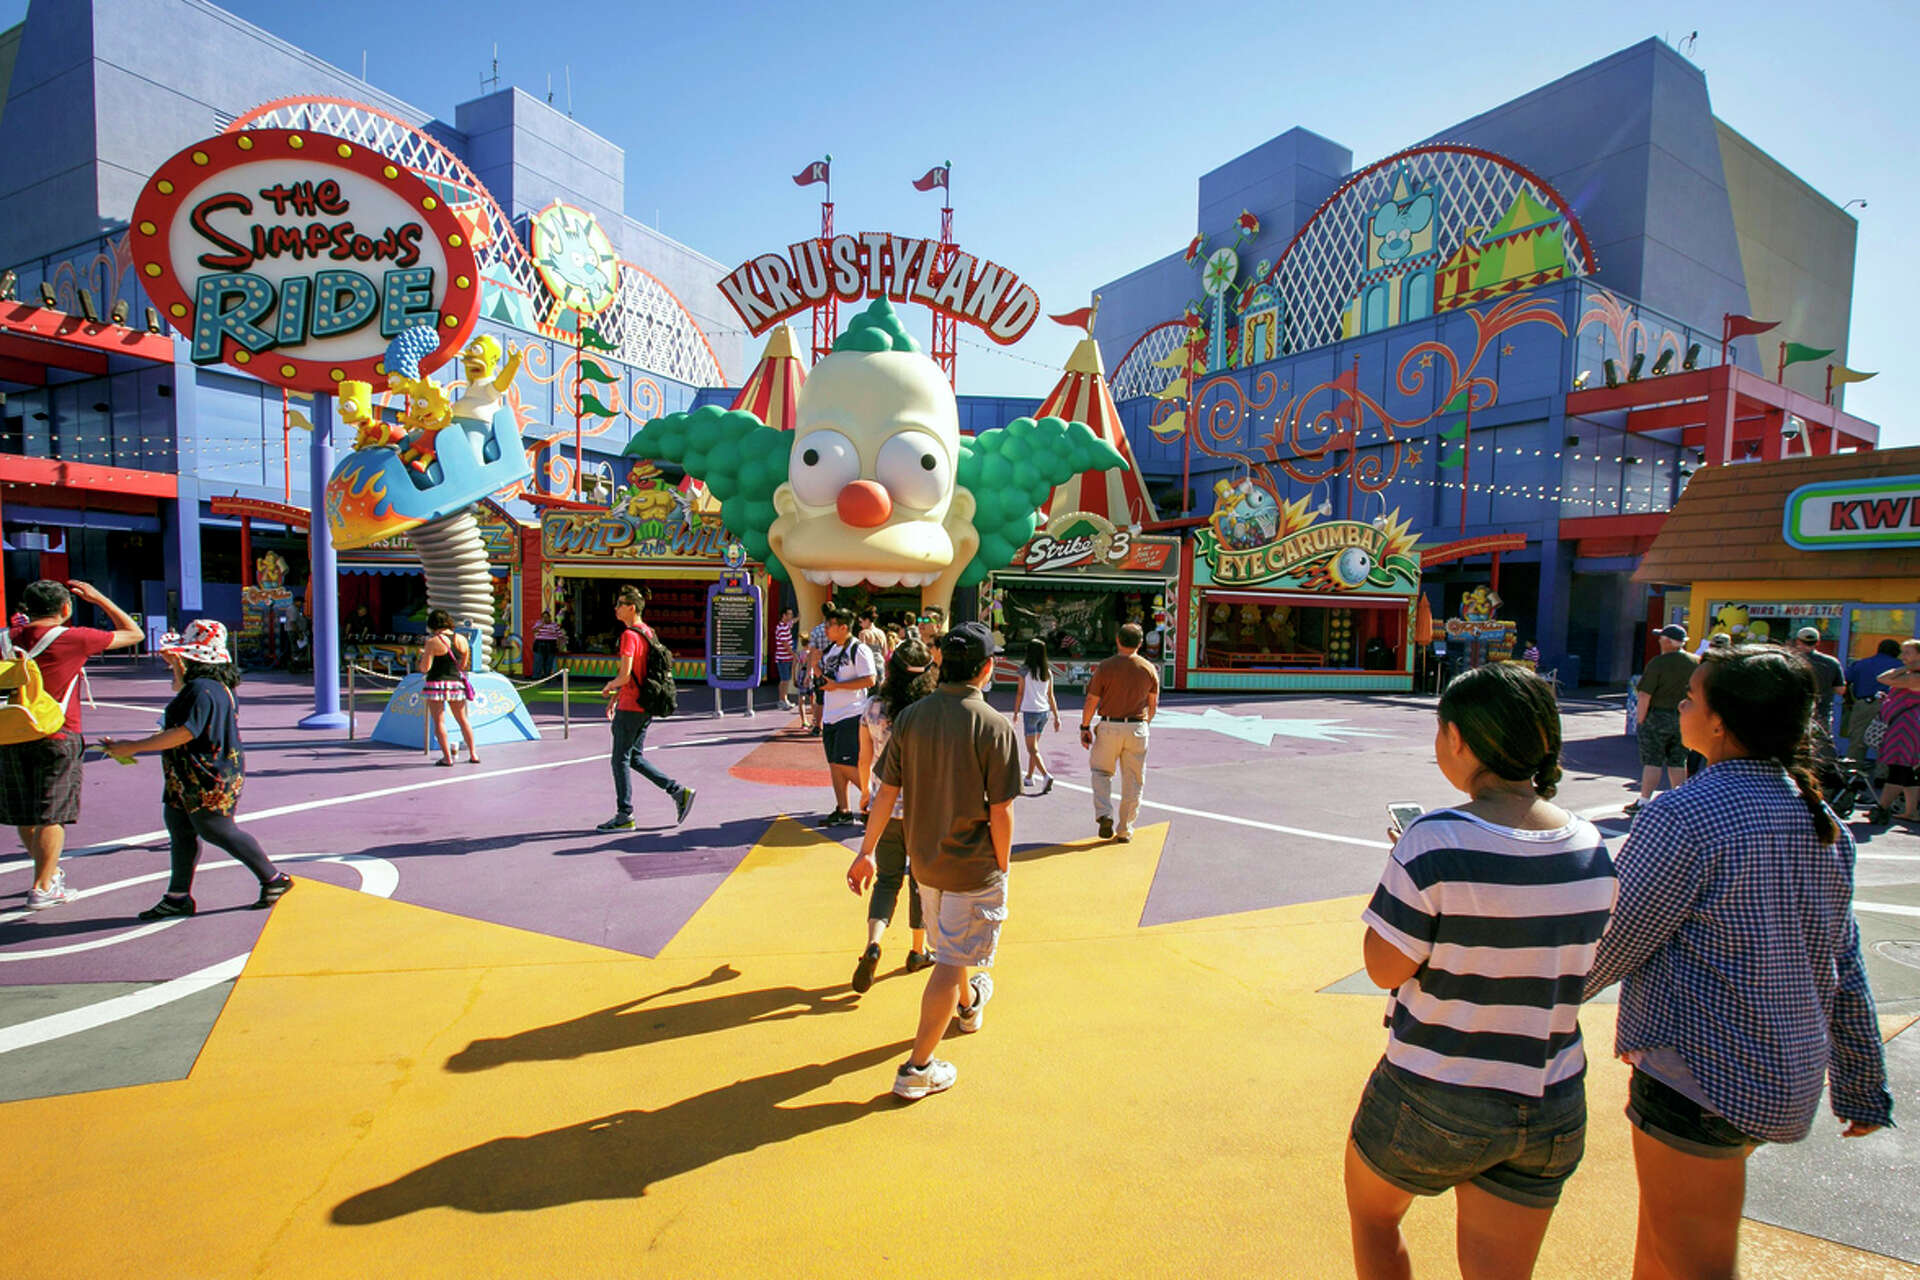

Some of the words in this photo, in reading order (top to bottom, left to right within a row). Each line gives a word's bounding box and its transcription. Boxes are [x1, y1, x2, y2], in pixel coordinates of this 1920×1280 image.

[812, 163, 824, 180] K
[933, 169, 944, 186] K
[190, 192, 423, 271] SIMPSONS
[719, 232, 1040, 342] KRUSTYLAND
[191, 267, 440, 363] RIDE
[1026, 536, 1093, 564] Strike
[1108, 532, 1130, 560] 3
[1217, 551, 1265, 579] EYE
[1264, 525, 1384, 571] CARUMBA!
